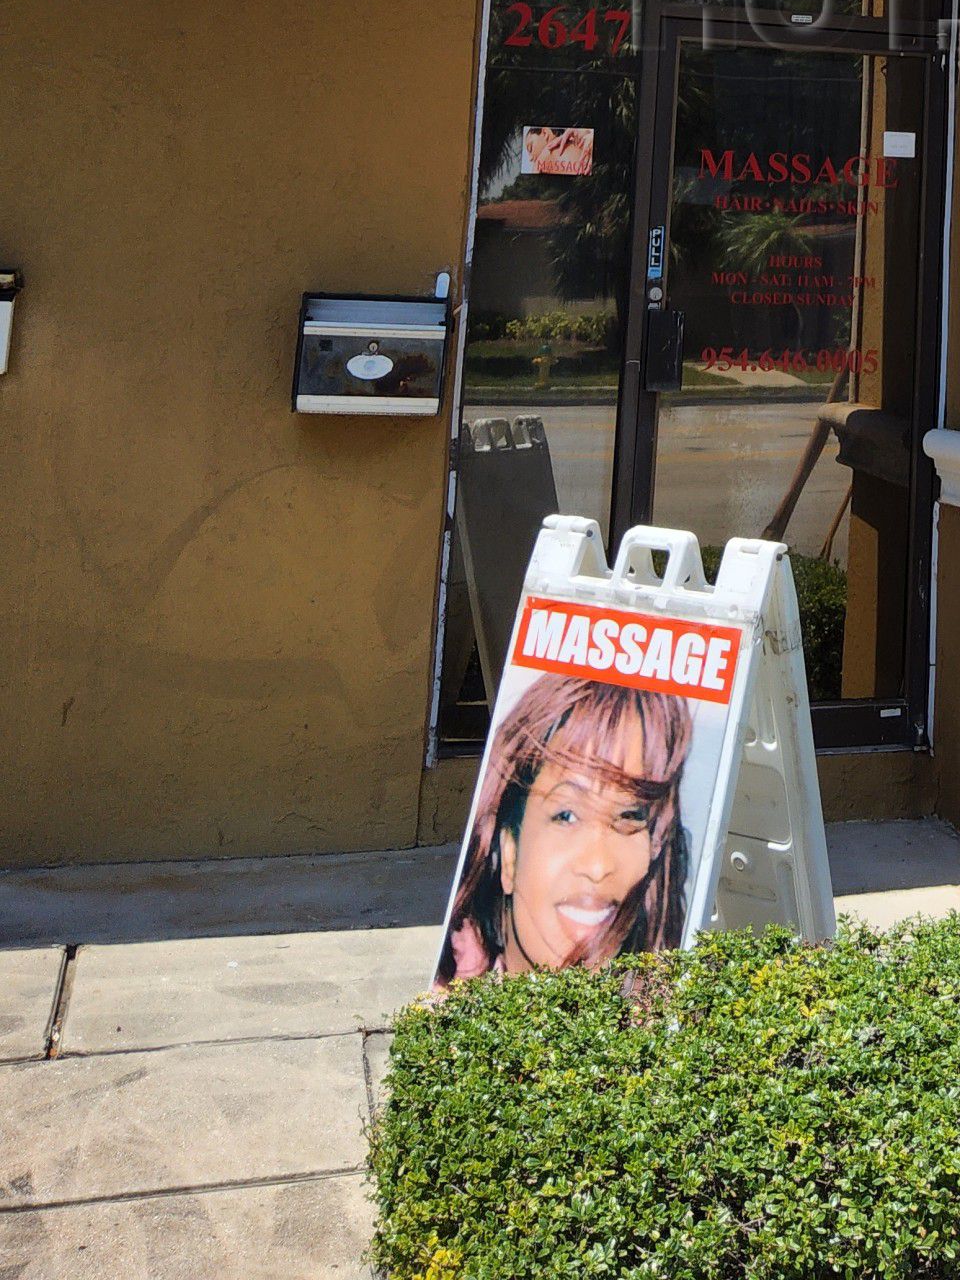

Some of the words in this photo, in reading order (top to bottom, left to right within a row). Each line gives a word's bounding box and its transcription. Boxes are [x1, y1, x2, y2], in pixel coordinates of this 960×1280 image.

[503, 2, 632, 56] 2647
[697, 148, 898, 189] MASSAGE
[650, 228, 662, 266] PULL
[768, 255, 823, 268] HOURS
[711, 272, 748, 286] MON
[797, 274, 834, 289] 11AM
[731, 291, 793, 306] CLOSED
[796, 292, 857, 307] SUNDAY
[522, 609, 731, 691] MASSAGE
